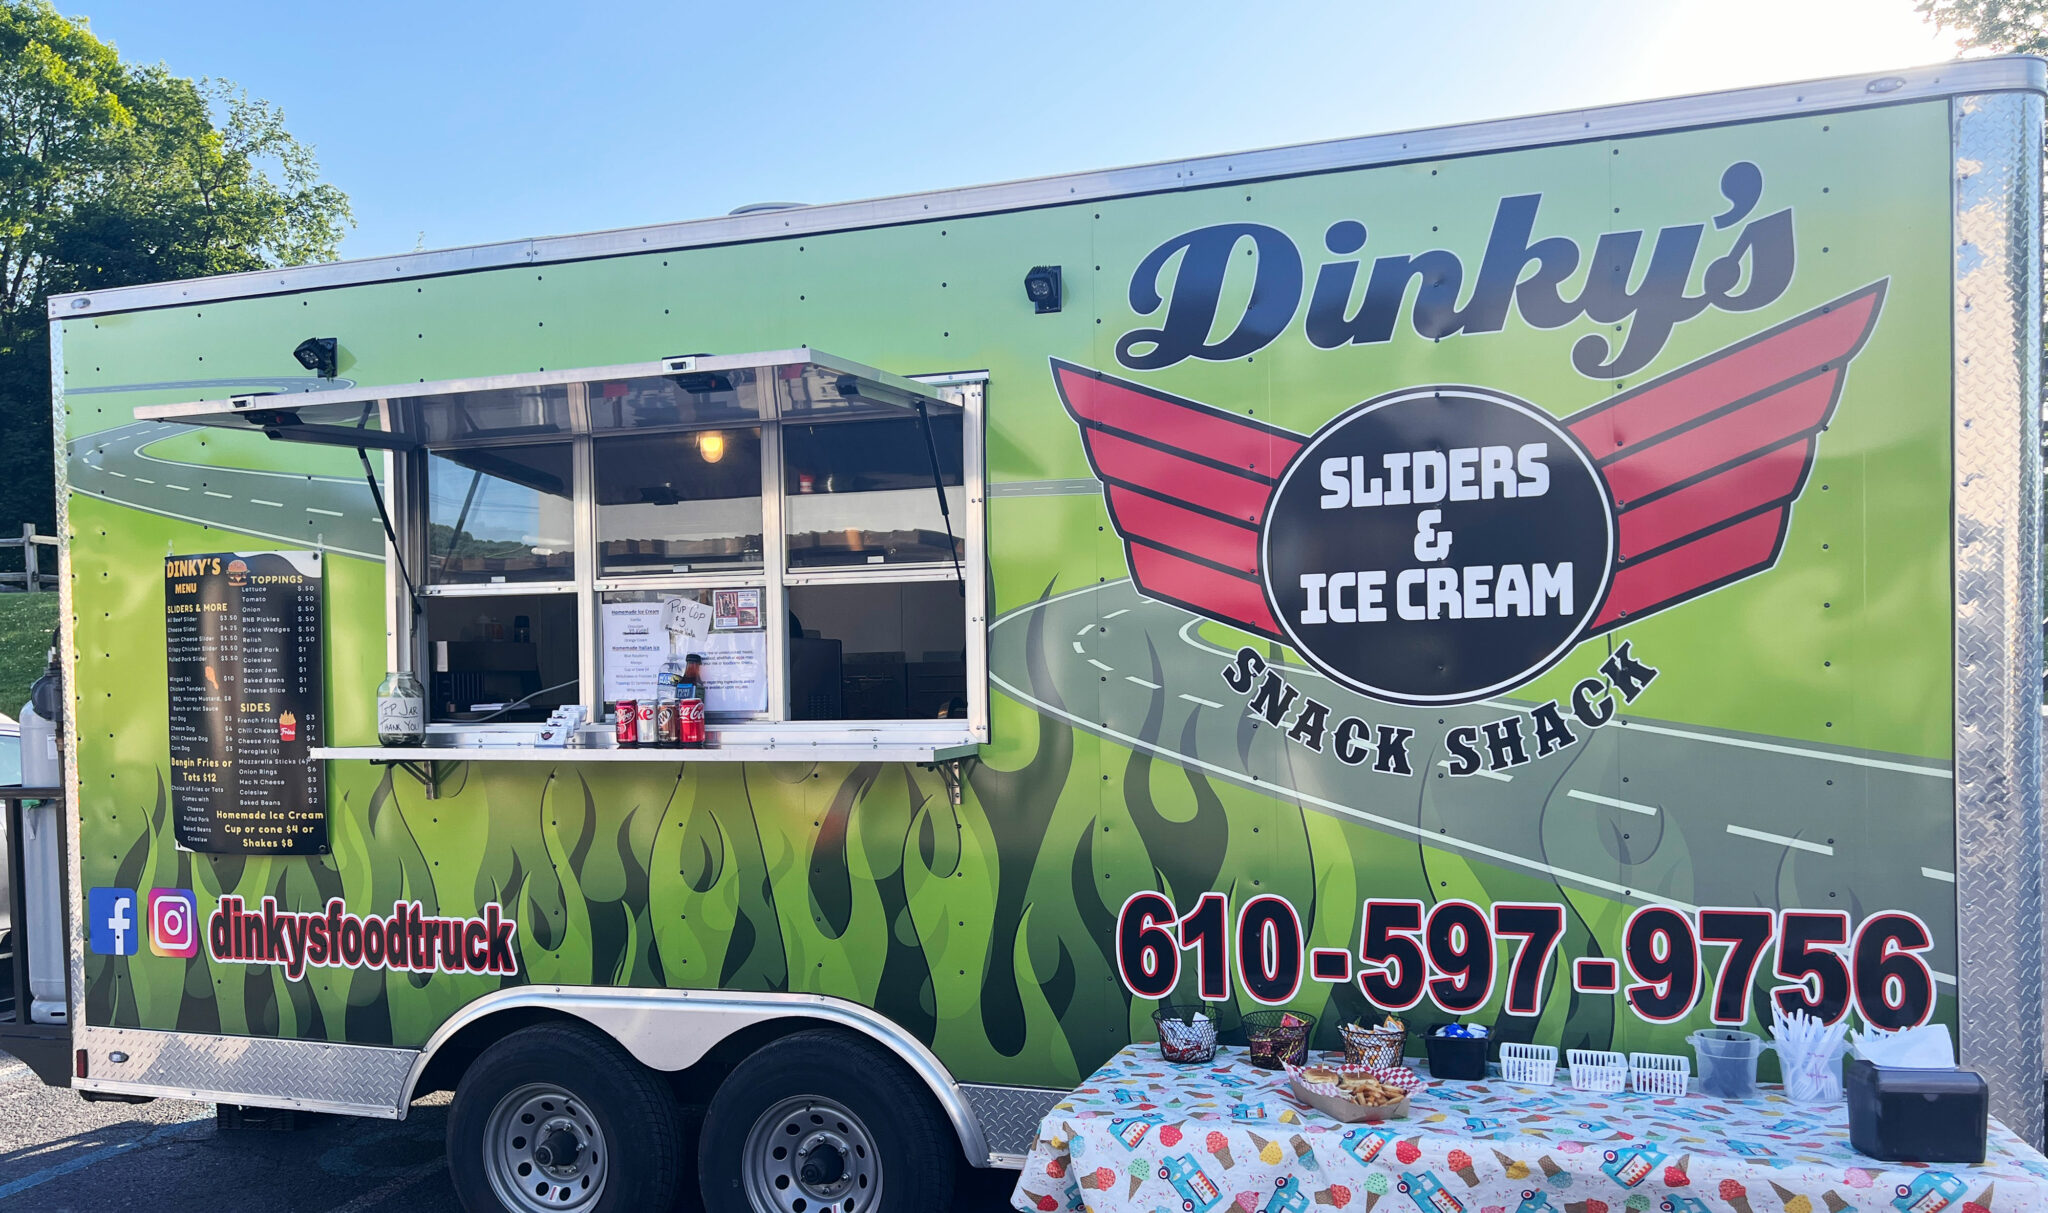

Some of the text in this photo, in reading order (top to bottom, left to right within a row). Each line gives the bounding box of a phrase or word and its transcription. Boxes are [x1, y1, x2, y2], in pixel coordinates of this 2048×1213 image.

[1115, 160, 1798, 381] Dinky's
[1320, 442, 1549, 509] SLIDERS
[1414, 509, 1452, 561] &
[167, 558, 221, 578] DINKY'S
[251, 576, 303, 584] TOPPINGS
[175, 583, 197, 594] MENU
[1300, 561, 1574, 624] ICE CREAM
[168, 605, 193, 613] SLIDERS
[204, 603, 227, 611] MORE
[240, 703, 270, 712] SIDES
[1221, 640, 1659, 776] SNACK SHACK
[172, 757, 194, 768] Bangin
[197, 758, 219, 767] Fries
[183, 772, 216, 782] Tots $12
[216, 810, 323, 819] Homemade Ice Cream
[225, 824, 241, 835] Cup
[287, 825, 298, 834] $4
[243, 839, 293, 848] Shakes $8
[207, 895, 518, 982] dinkysfoodtruck
[1116, 891, 1937, 1030] 610-597-9756
